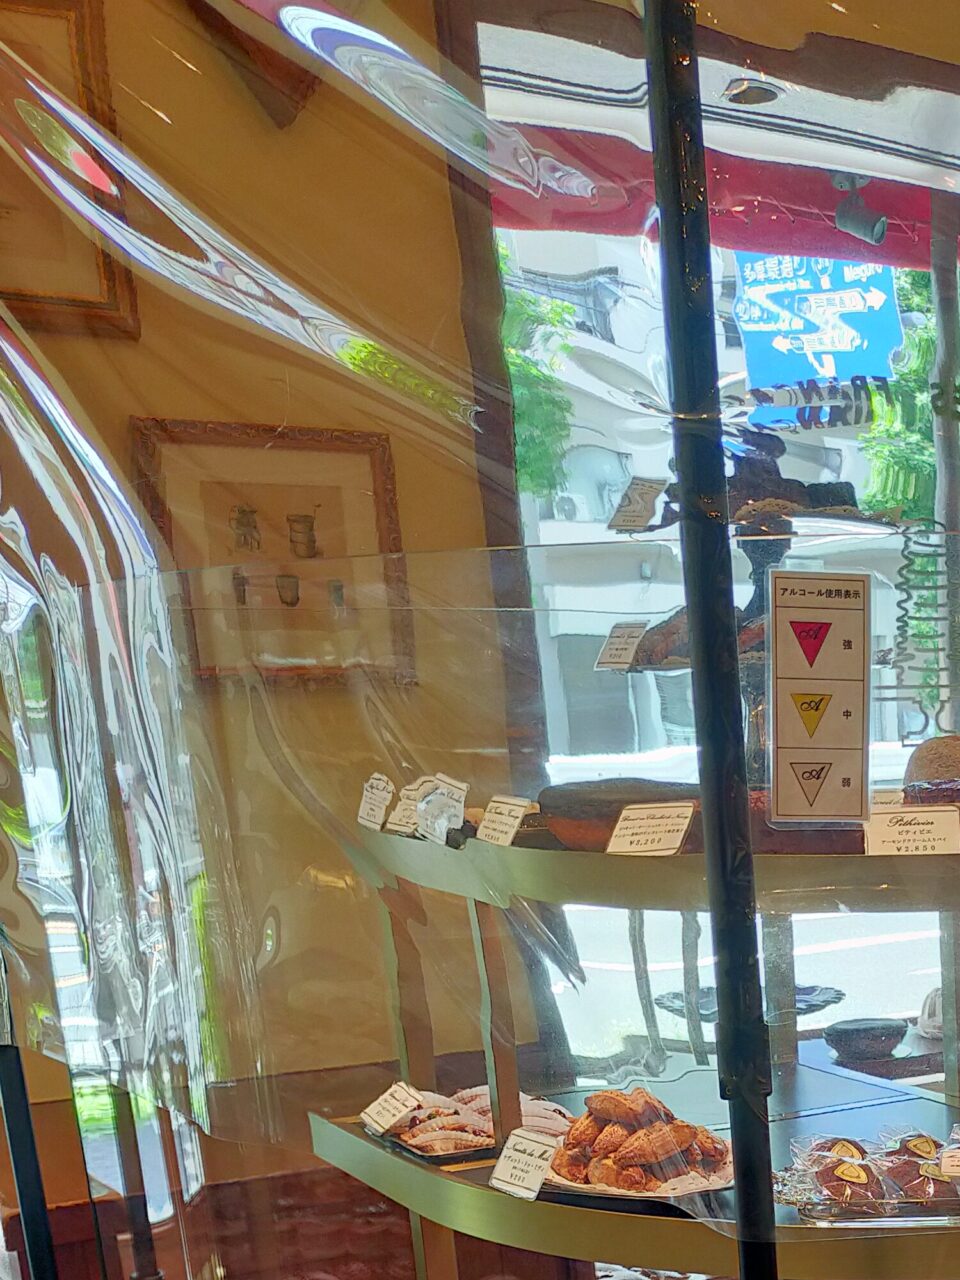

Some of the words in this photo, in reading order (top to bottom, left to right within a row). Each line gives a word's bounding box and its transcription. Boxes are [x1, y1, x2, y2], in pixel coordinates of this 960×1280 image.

[780, 587, 861, 600] アルコール使用表示
[842, 709, 853, 720] 中
